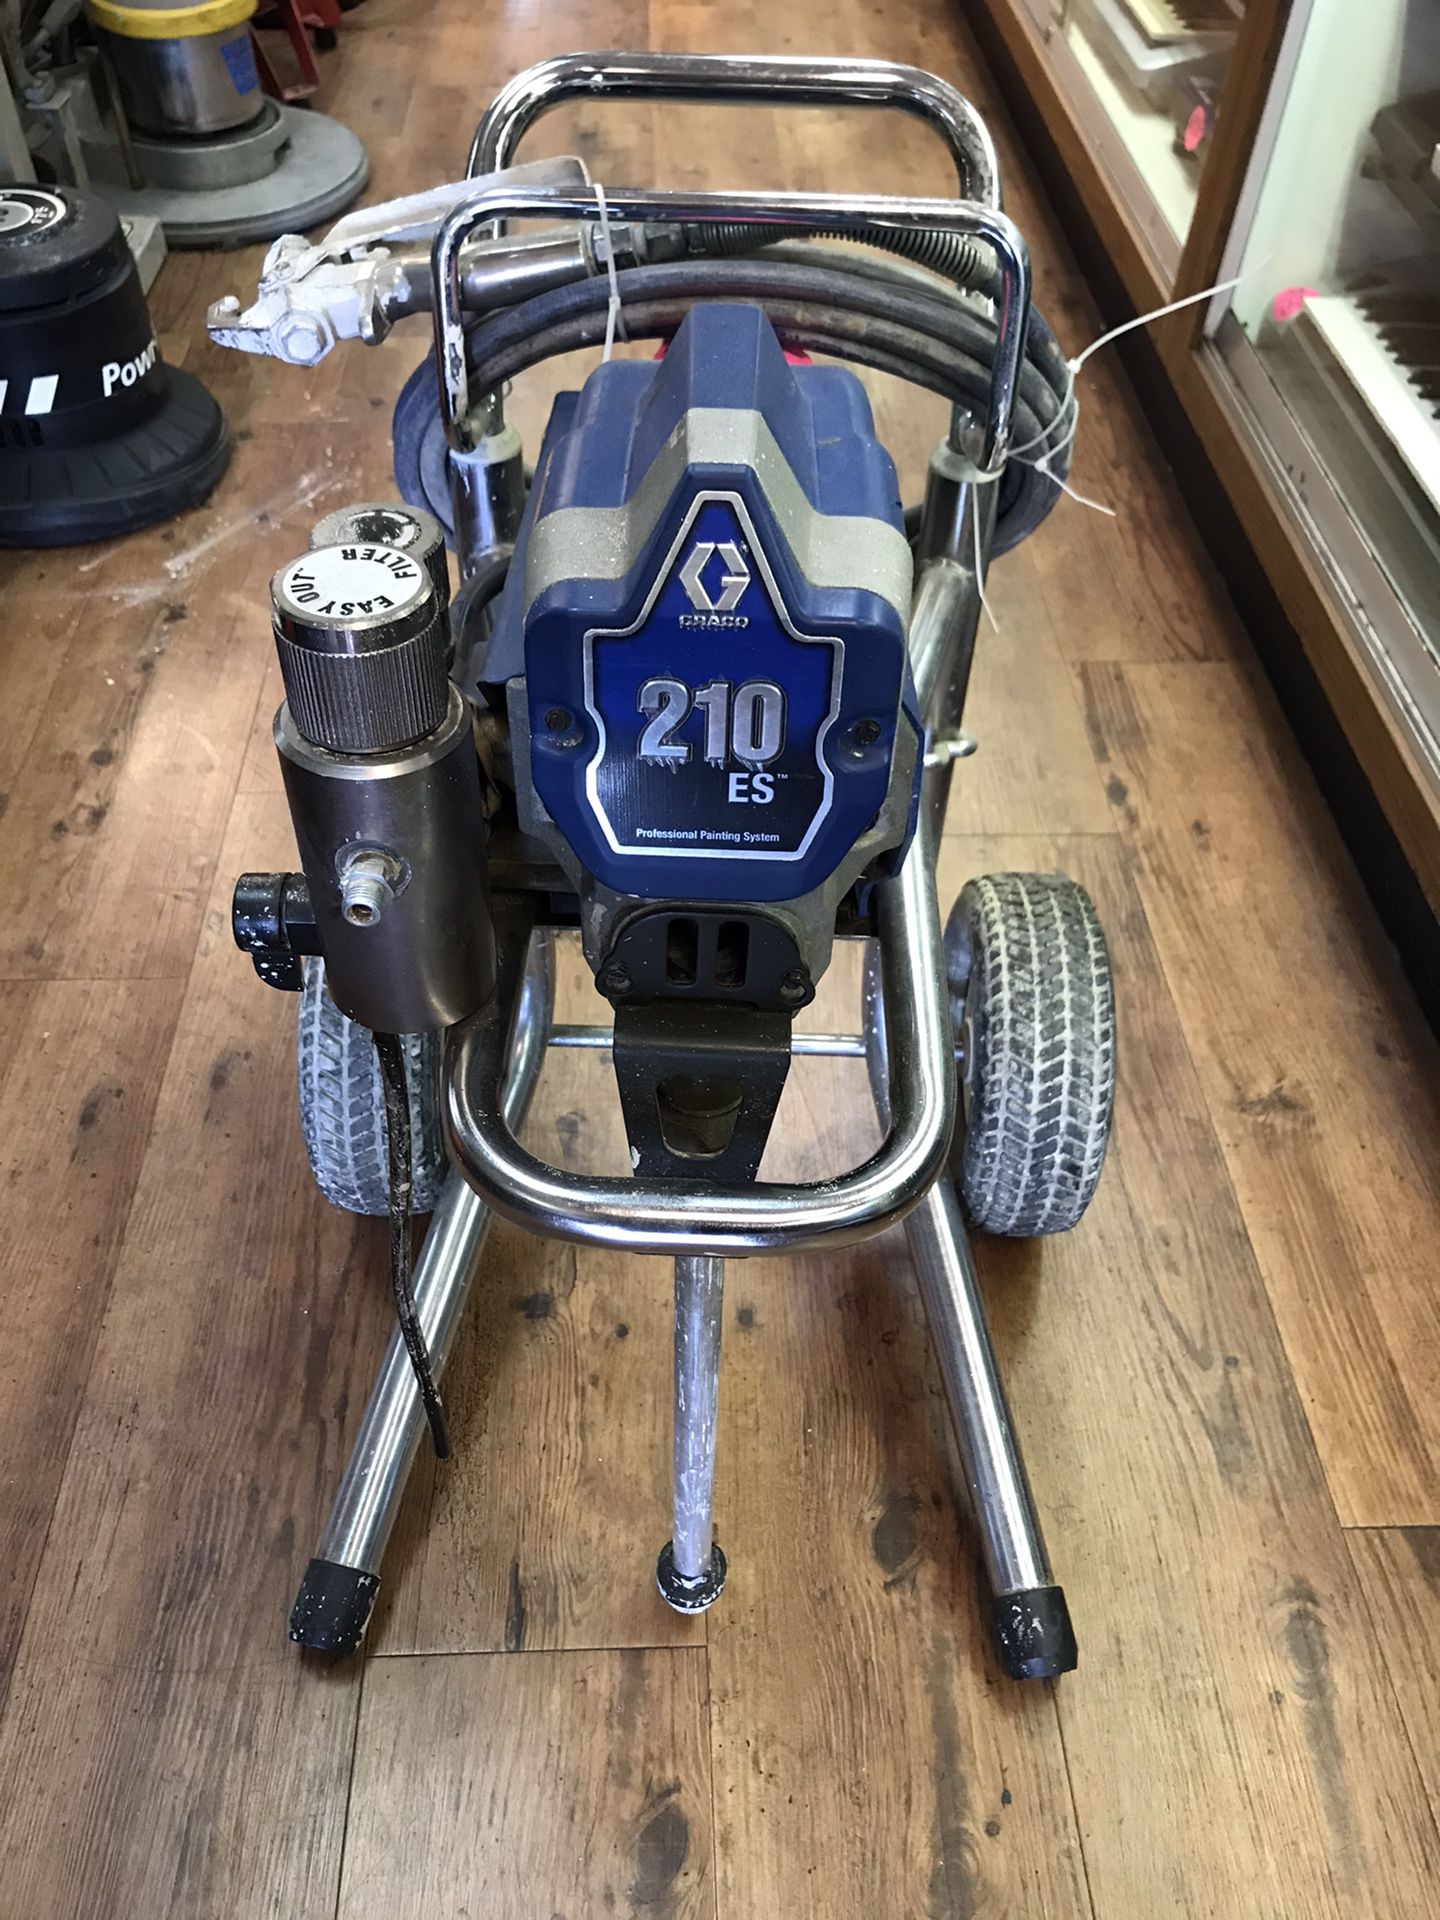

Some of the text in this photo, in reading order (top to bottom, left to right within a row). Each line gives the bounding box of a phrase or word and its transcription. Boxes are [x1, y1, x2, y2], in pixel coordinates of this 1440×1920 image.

[341, 548, 418, 580] FILTER
[317, 595, 394, 616] EASY
[678, 614, 749, 628] GRACO
[637, 677, 787, 764] 210
[635, 828, 780, 843] Professional Painting System
